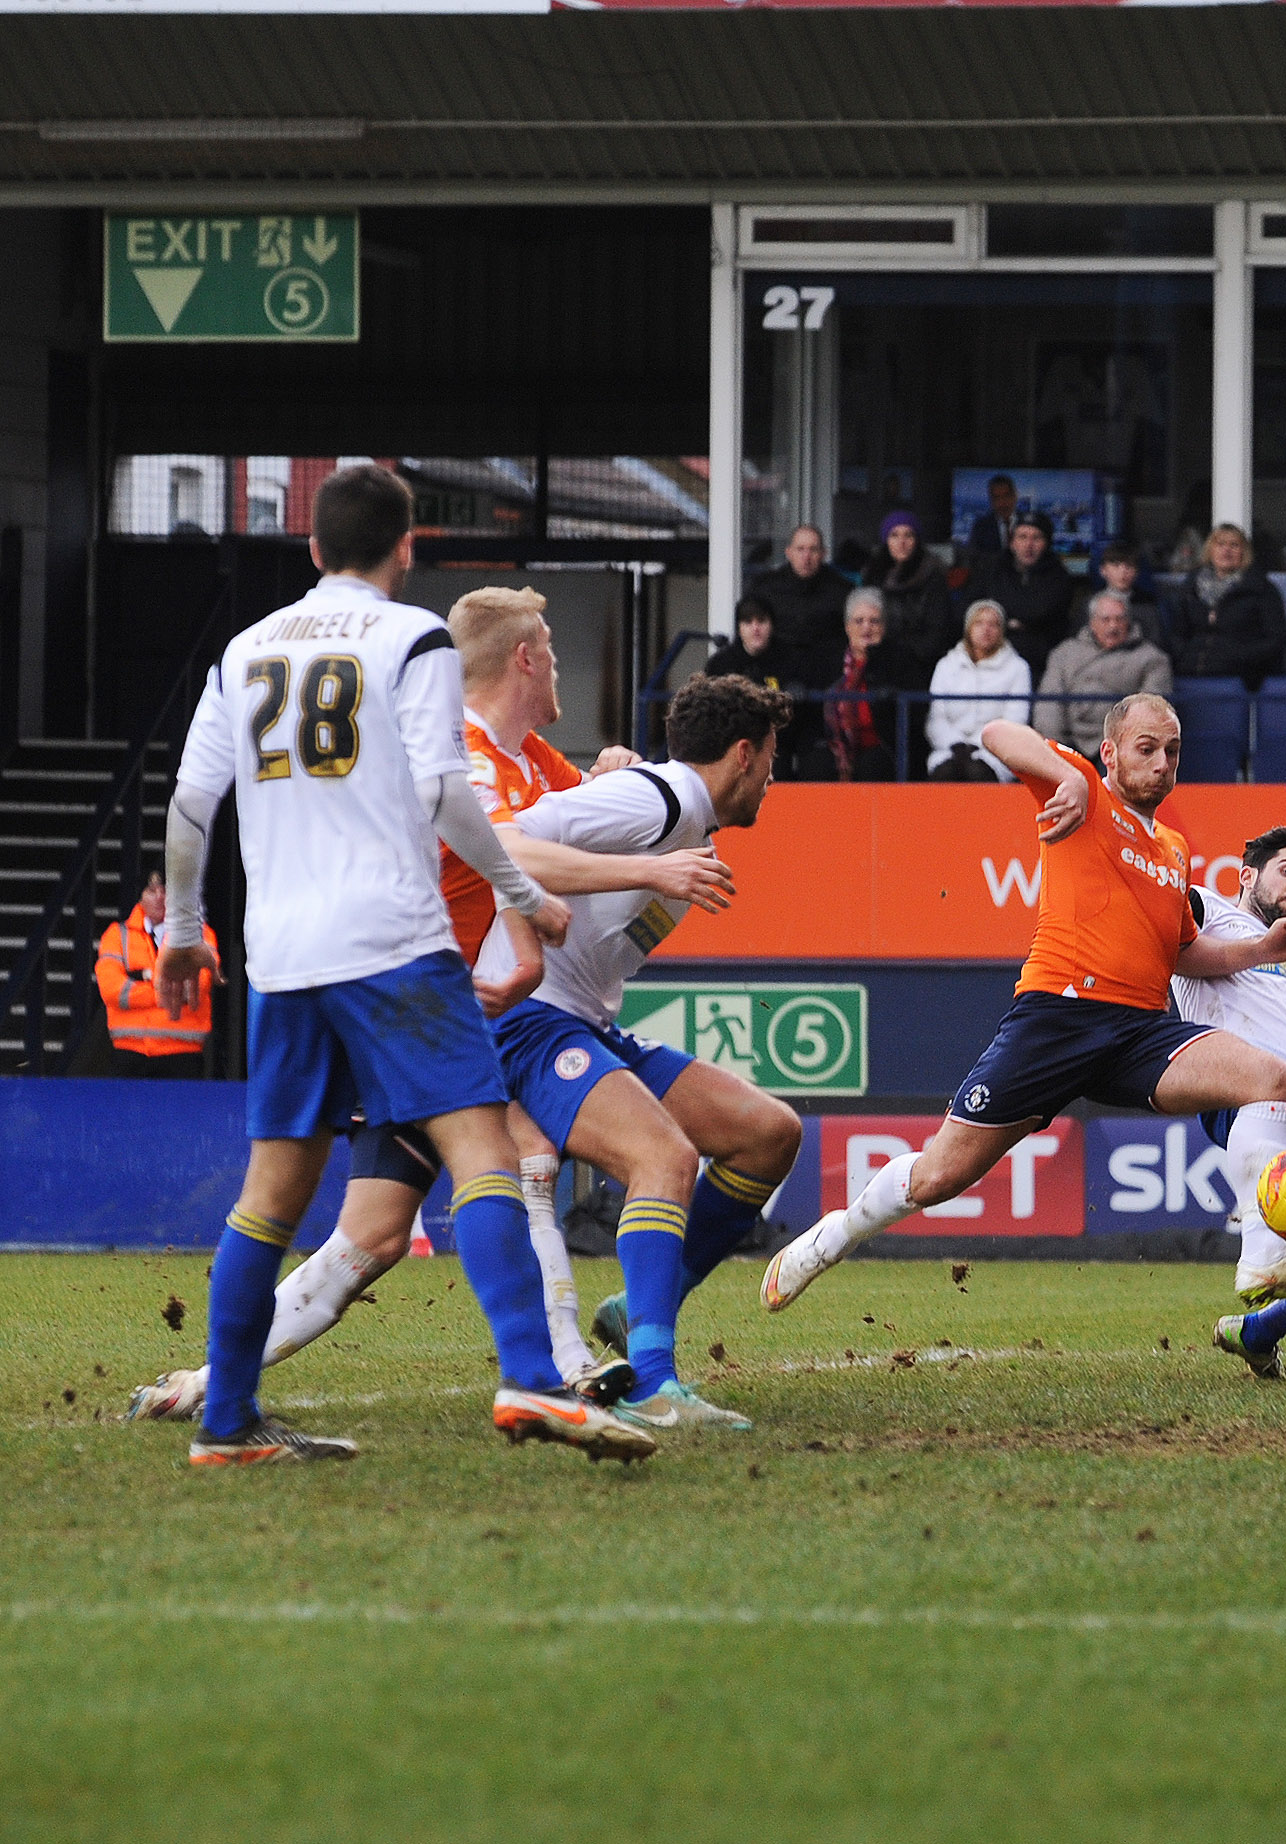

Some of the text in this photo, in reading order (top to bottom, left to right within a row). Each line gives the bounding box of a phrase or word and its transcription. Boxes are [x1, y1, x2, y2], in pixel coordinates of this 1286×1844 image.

[126, 219, 243, 262] EXIT
[282, 279, 311, 323] 5
[762, 285, 835, 331] 27
[245, 652, 364, 783] 28
[790, 1011, 829, 1068] 5
